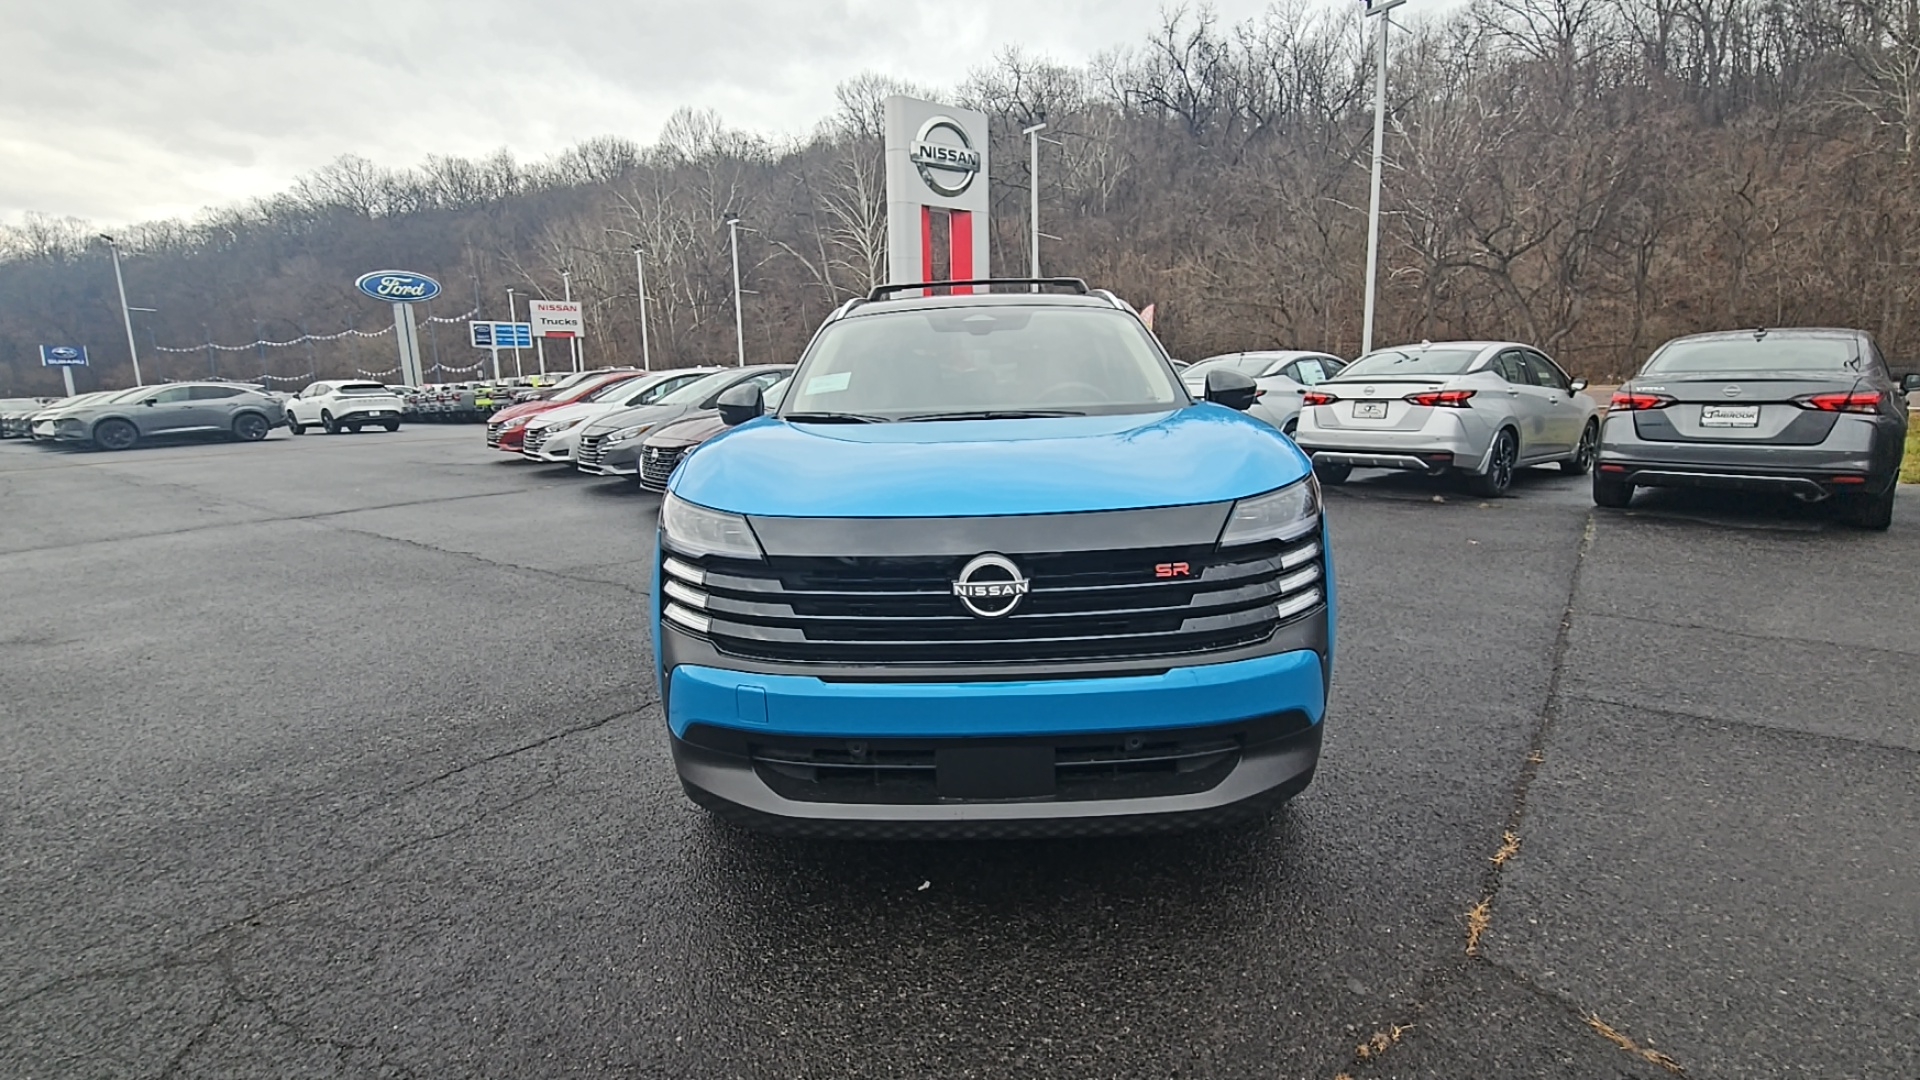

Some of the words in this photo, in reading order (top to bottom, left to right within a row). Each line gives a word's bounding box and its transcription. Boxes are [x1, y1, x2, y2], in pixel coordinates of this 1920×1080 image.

[920, 145, 976, 166] NISSAN
[377, 276, 424, 296] Ford
[538, 304, 577, 312] NISSAN
[540, 318, 578, 326] Trucks
[1155, 562, 1190, 577] SR
[953, 583, 1028, 597] NISSAN
